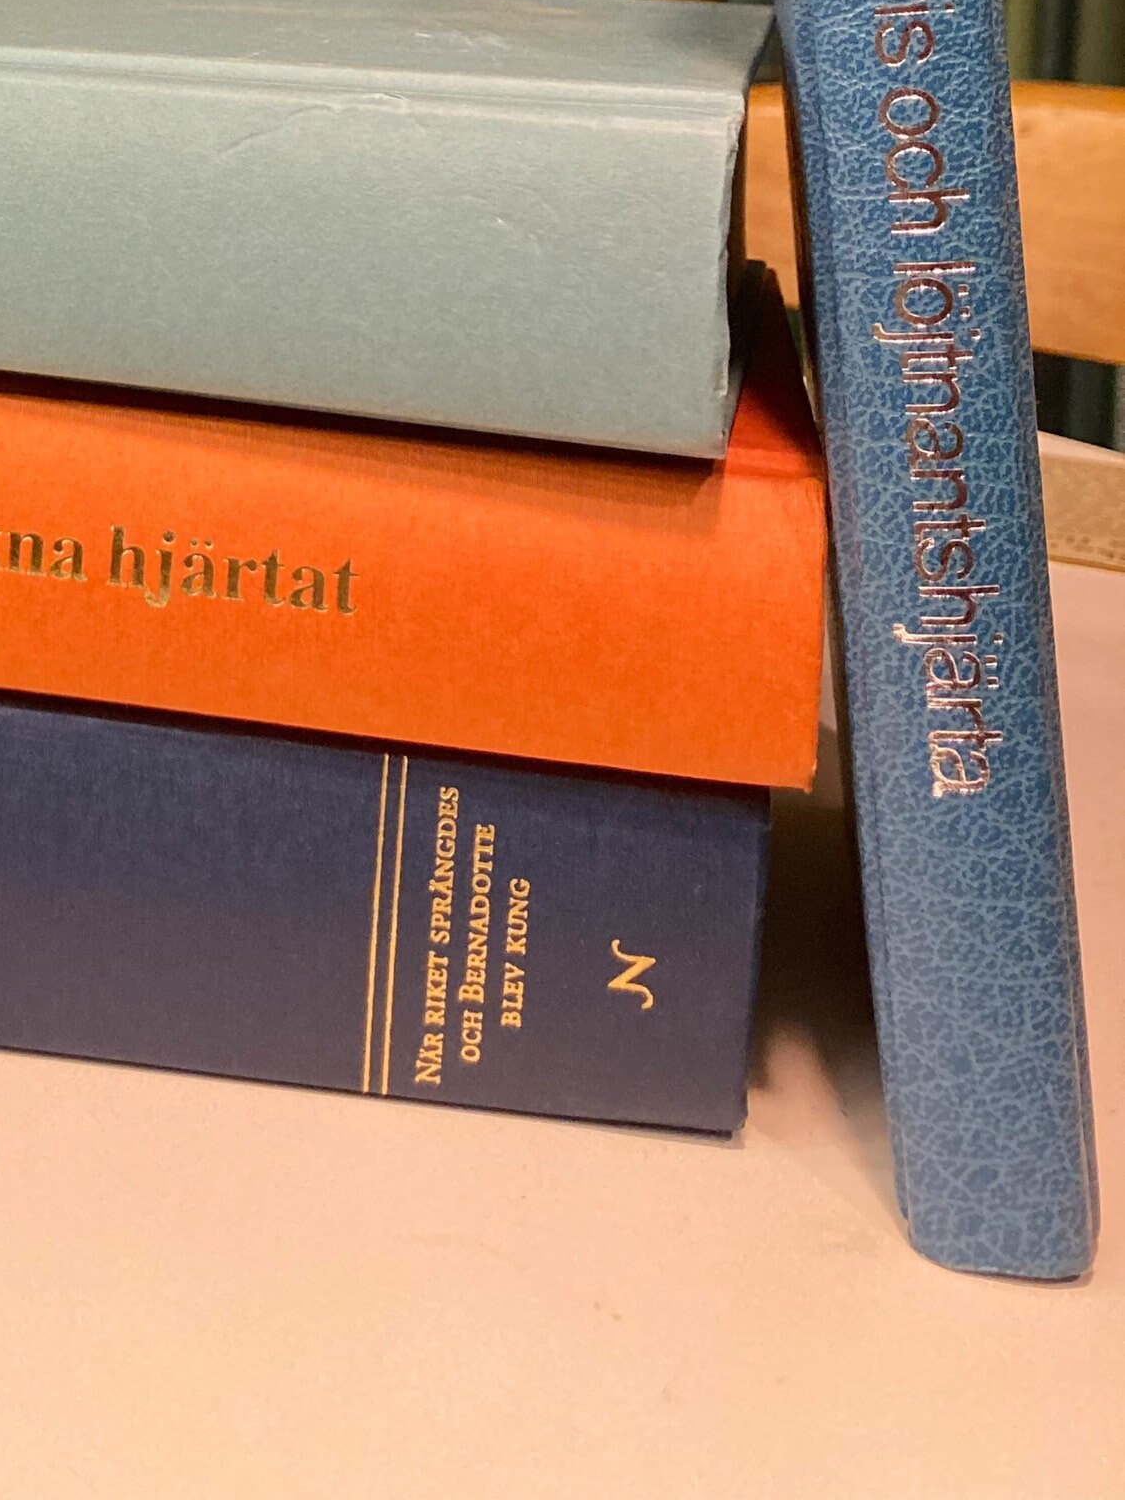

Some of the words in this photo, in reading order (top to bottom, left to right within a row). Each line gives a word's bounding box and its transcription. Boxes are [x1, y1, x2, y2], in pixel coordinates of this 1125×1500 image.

[880, 87, 970, 235] och
[106, 525, 357, 615] hjärtat
[874, 259, 1002, 799] löjtnantshjärta
[428, 786, 460, 945] SPRÄNGDES
[458, 823, 496, 1004] BERNADOTTE
[505, 877, 532, 955] KUNG
[424, 950, 449, 1027] RIKET
[500, 962, 525, 1028] BLEV
[415, 1032, 444, 1085] NÄR
[460, 1009, 484, 1064] OCH
